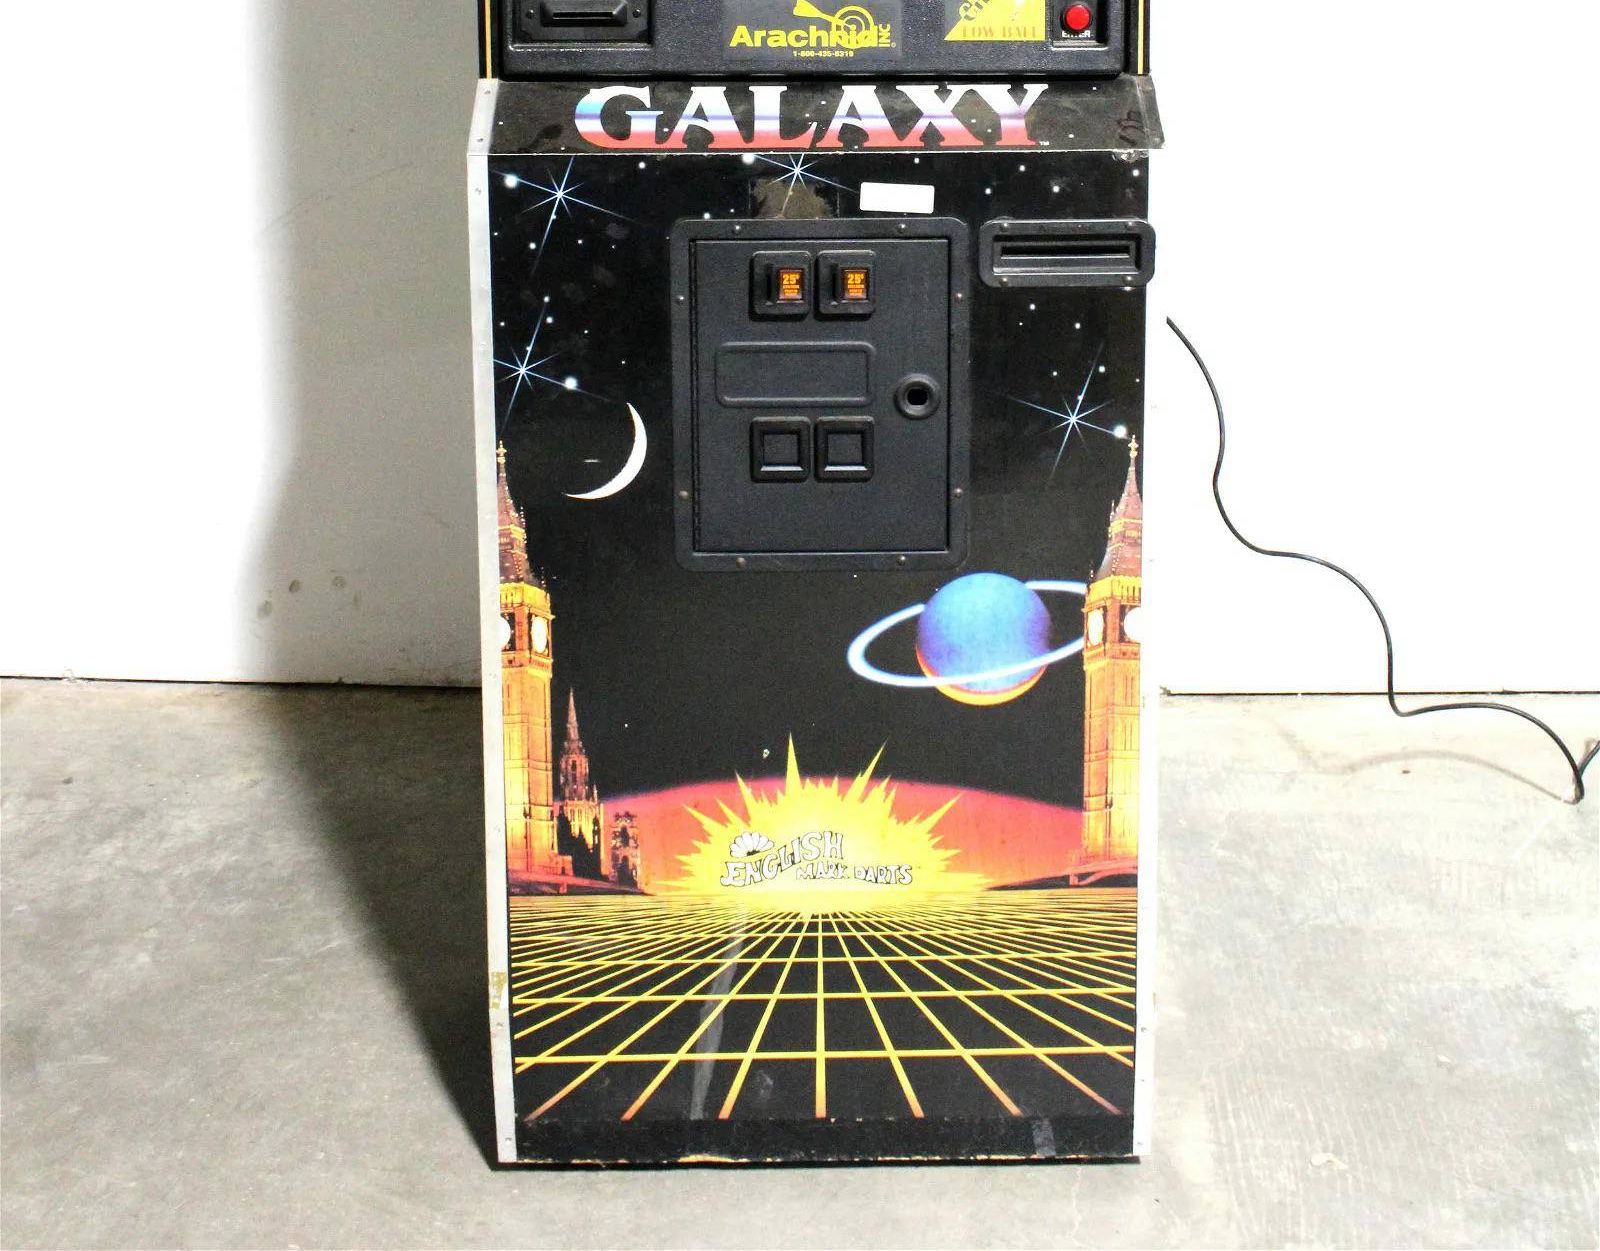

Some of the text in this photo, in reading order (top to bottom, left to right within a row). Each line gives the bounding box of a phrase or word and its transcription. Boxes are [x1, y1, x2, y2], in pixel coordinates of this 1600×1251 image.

[730, 24, 878, 48] Arachnid
[574, 84, 1048, 148] GALAXY
[720, 830, 844, 887] ENGLISH
[795, 860, 913, 885] MARK DARTS
